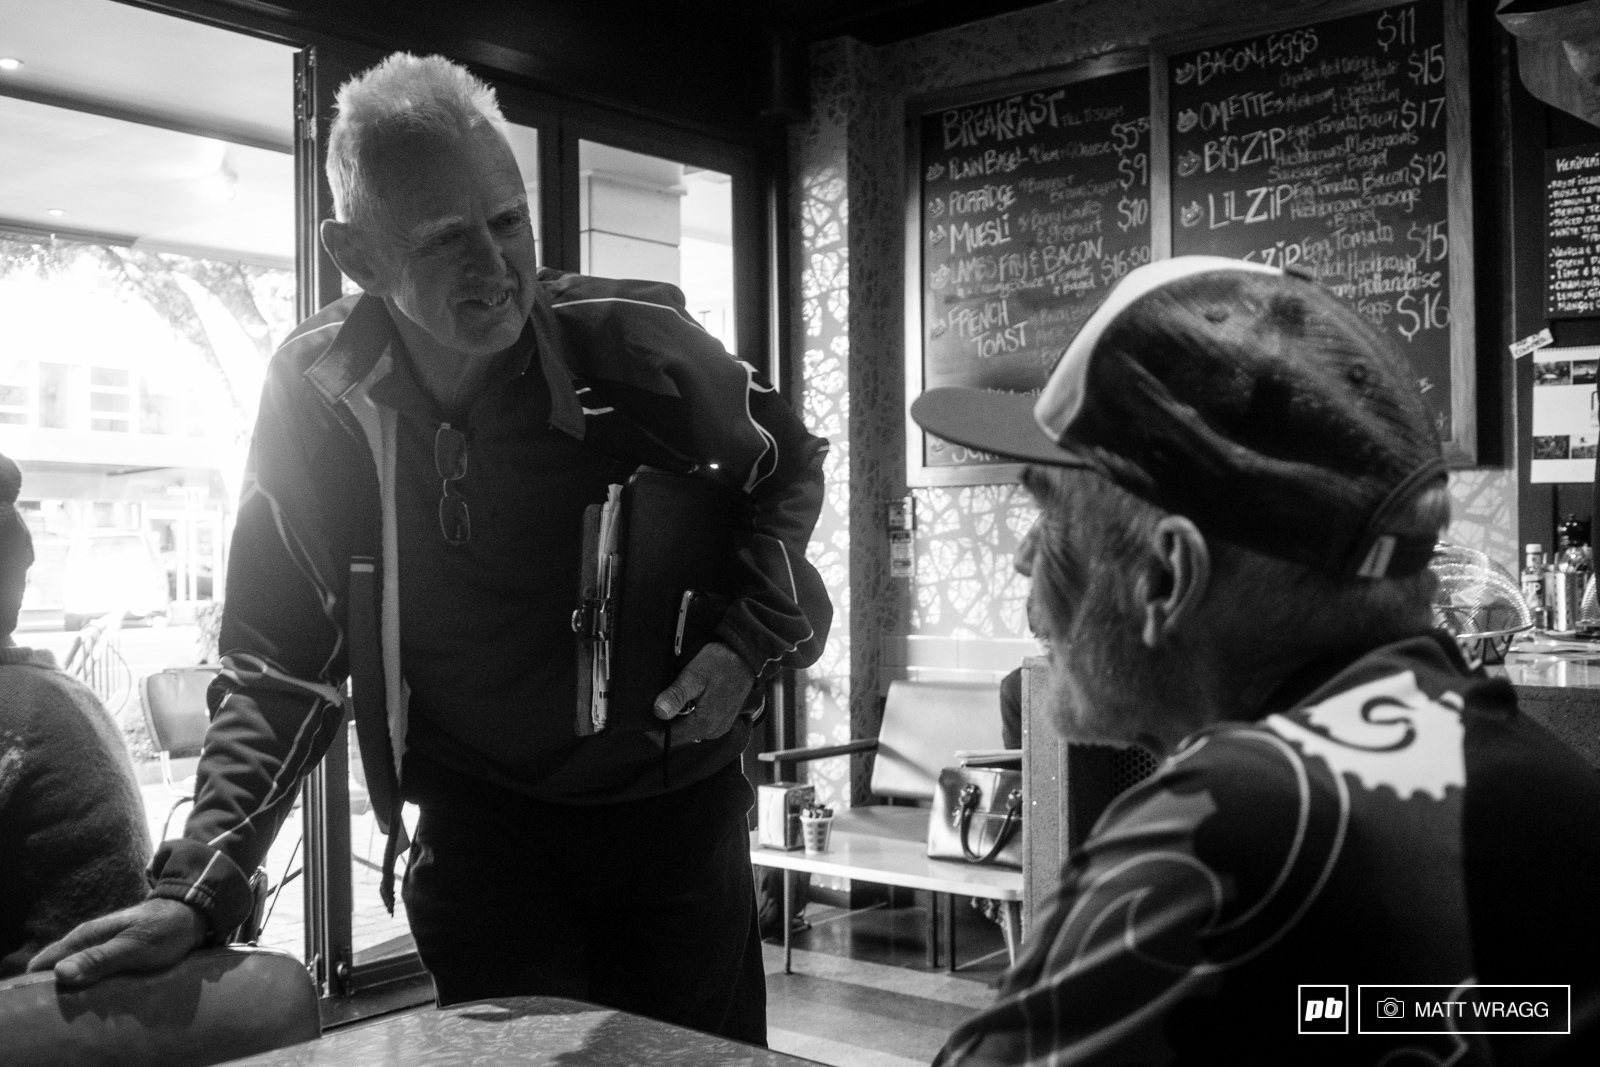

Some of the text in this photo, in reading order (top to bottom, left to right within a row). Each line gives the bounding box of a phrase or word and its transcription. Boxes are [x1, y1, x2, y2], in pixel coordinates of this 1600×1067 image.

[1377, 7, 1416, 51] $11
[1407, 43, 1446, 85] $15
[942, 90, 1065, 150] BREAKFAST
[1401, 97, 1446, 131] $17
[1117, 152, 1147, 190] $9
[1409, 150, 1447, 185] $12
[1117, 195, 1149, 232] $10
[1406, 219, 1448, 264] $15
[949, 299, 1009, 338] FRENCH
[1397, 289, 1451, 342] $16
[971, 321, 1029, 358] TOAST
